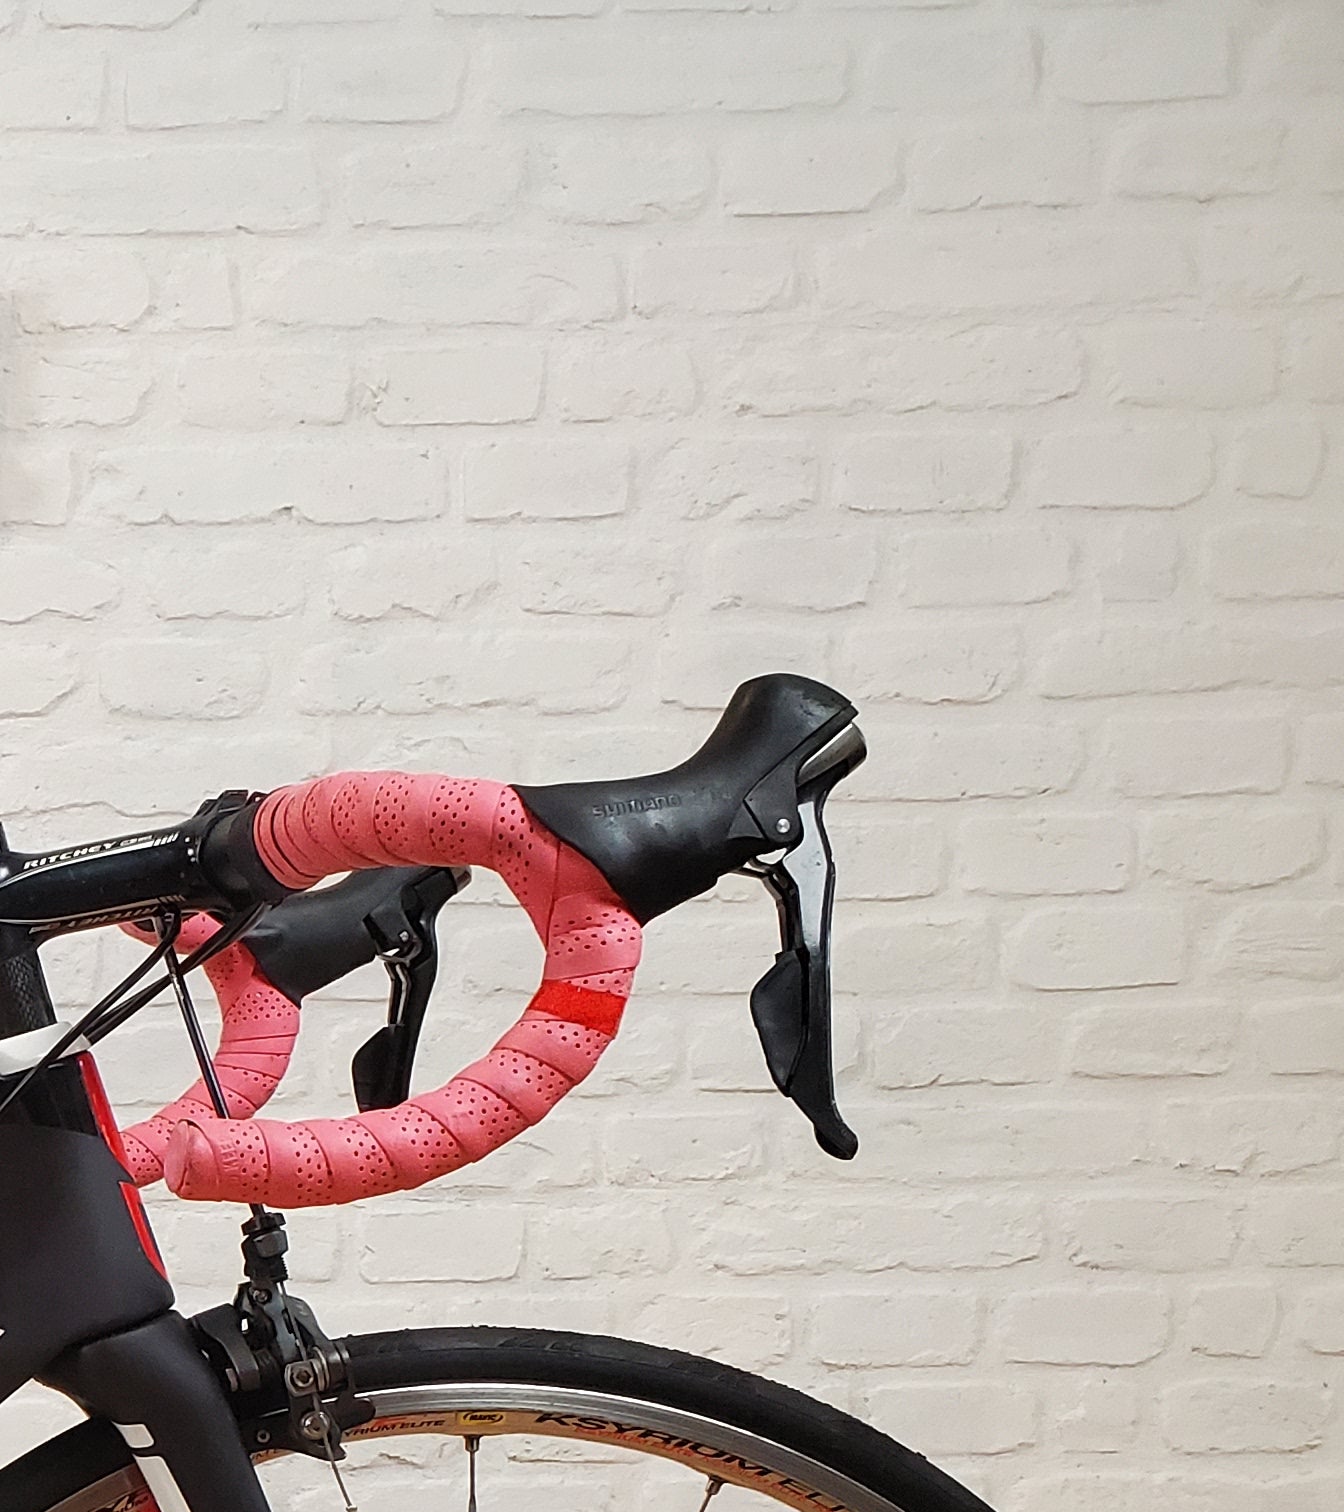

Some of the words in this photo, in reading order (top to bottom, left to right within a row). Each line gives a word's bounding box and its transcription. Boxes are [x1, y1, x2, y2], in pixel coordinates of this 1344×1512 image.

[23, 841, 117, 870] RITCHEY
[399, 1416, 446, 1429] ELITE
[534, 1409, 773, 1480] KSYRIUM
